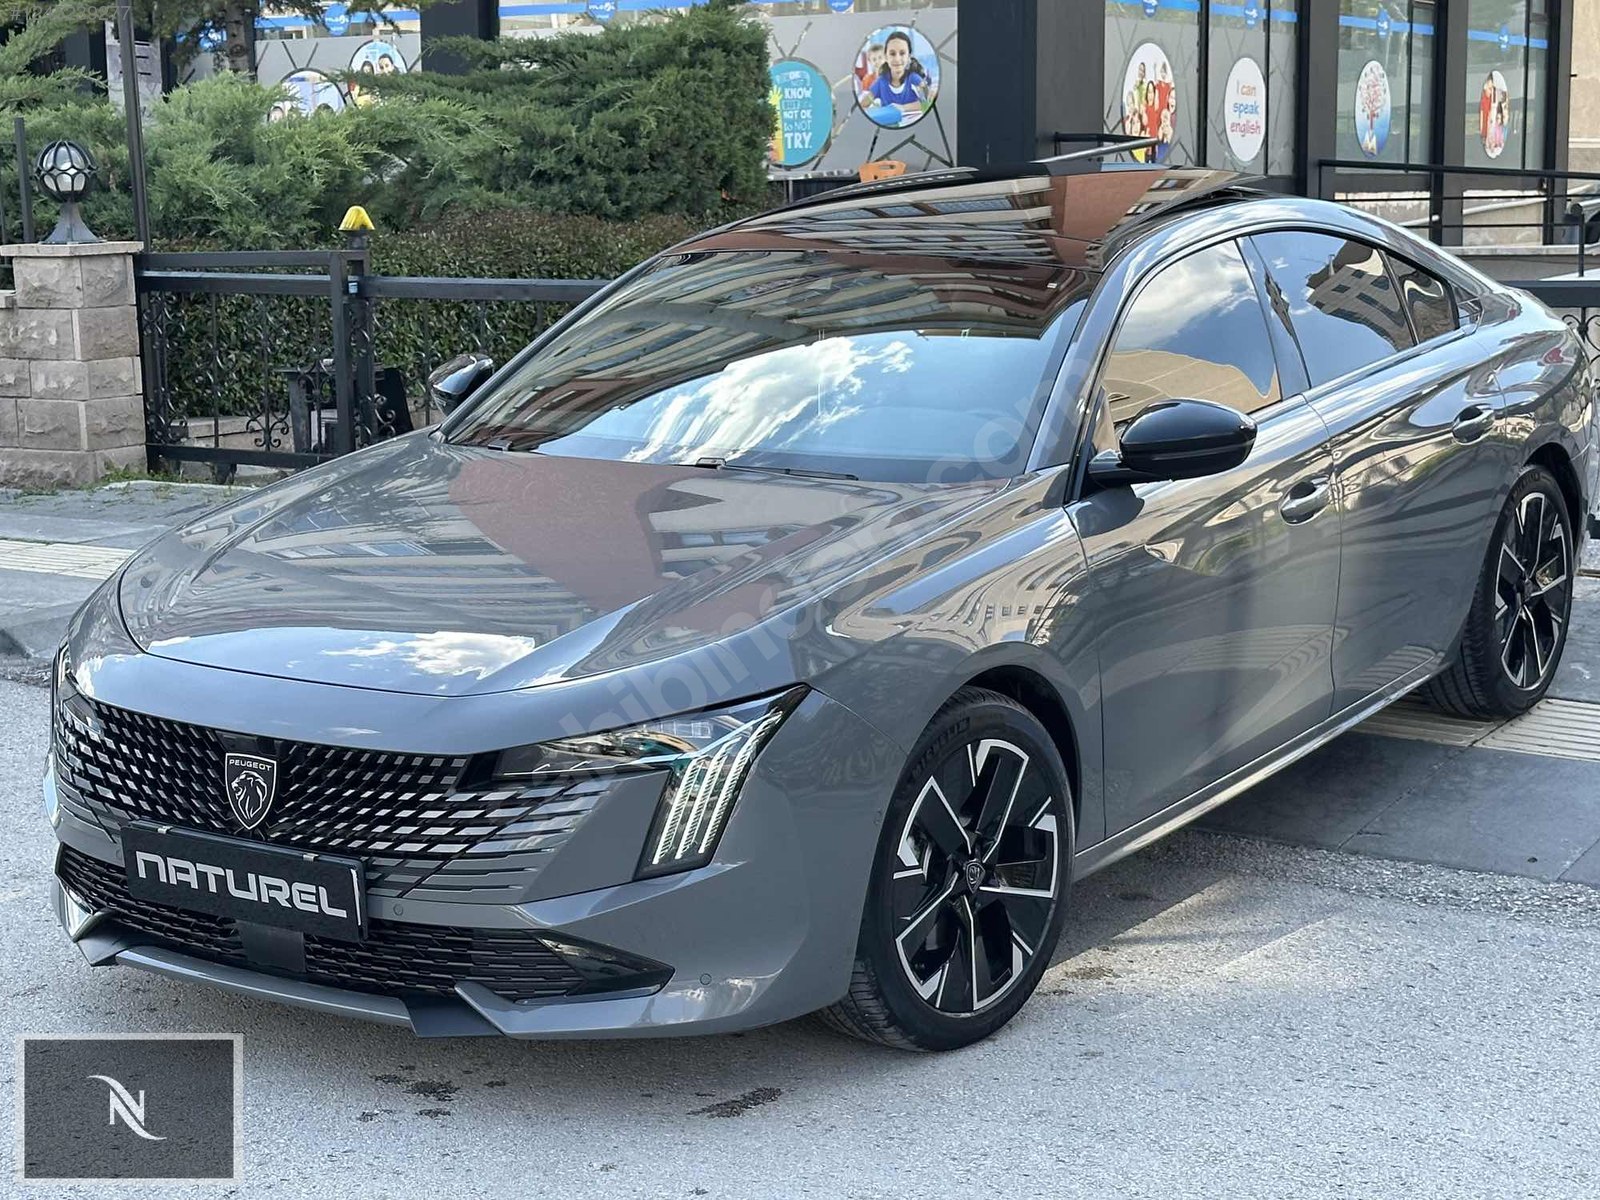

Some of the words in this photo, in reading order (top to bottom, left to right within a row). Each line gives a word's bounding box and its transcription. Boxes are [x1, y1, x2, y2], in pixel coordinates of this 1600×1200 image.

[784, 87, 812, 99] KNOW
[1240, 84, 1256, 96] can
[783, 110, 799, 119] NOT
[800, 109, 812, 119] OK
[1233, 101, 1259, 118] speak
[794, 120, 812, 131] NOT
[1230, 121, 1260, 137] english
[229, 759, 272, 772] PEUGEOT
[135, 850, 348, 919] NATUREL
